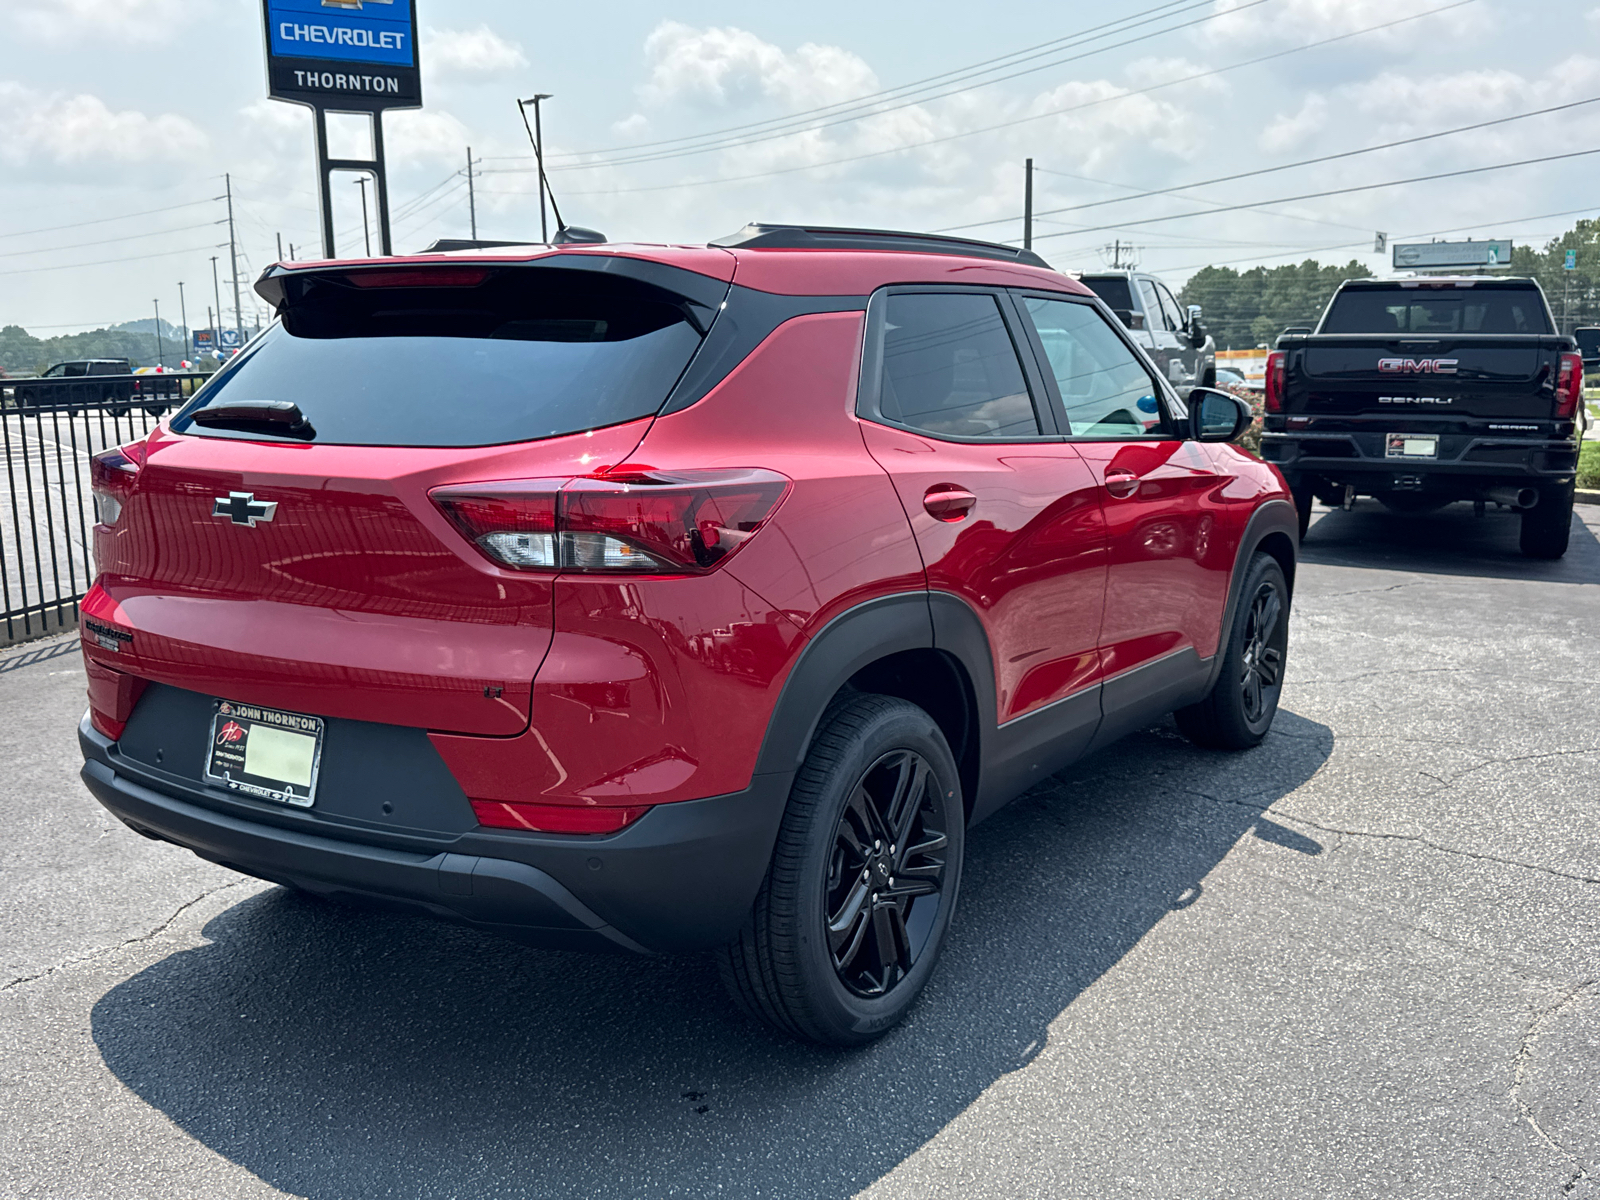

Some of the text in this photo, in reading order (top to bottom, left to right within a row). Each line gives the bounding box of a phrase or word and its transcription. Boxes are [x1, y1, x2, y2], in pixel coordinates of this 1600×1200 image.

[280, 23, 405, 49] CHEVROLET
[294, 71, 399, 93] THORNTON
[1378, 358, 1459, 373] GMC
[484, 686, 504, 698] LT
[236, 705, 316, 731] JOHN THORNTON
[239, 784, 271, 798] CHEVROLET
